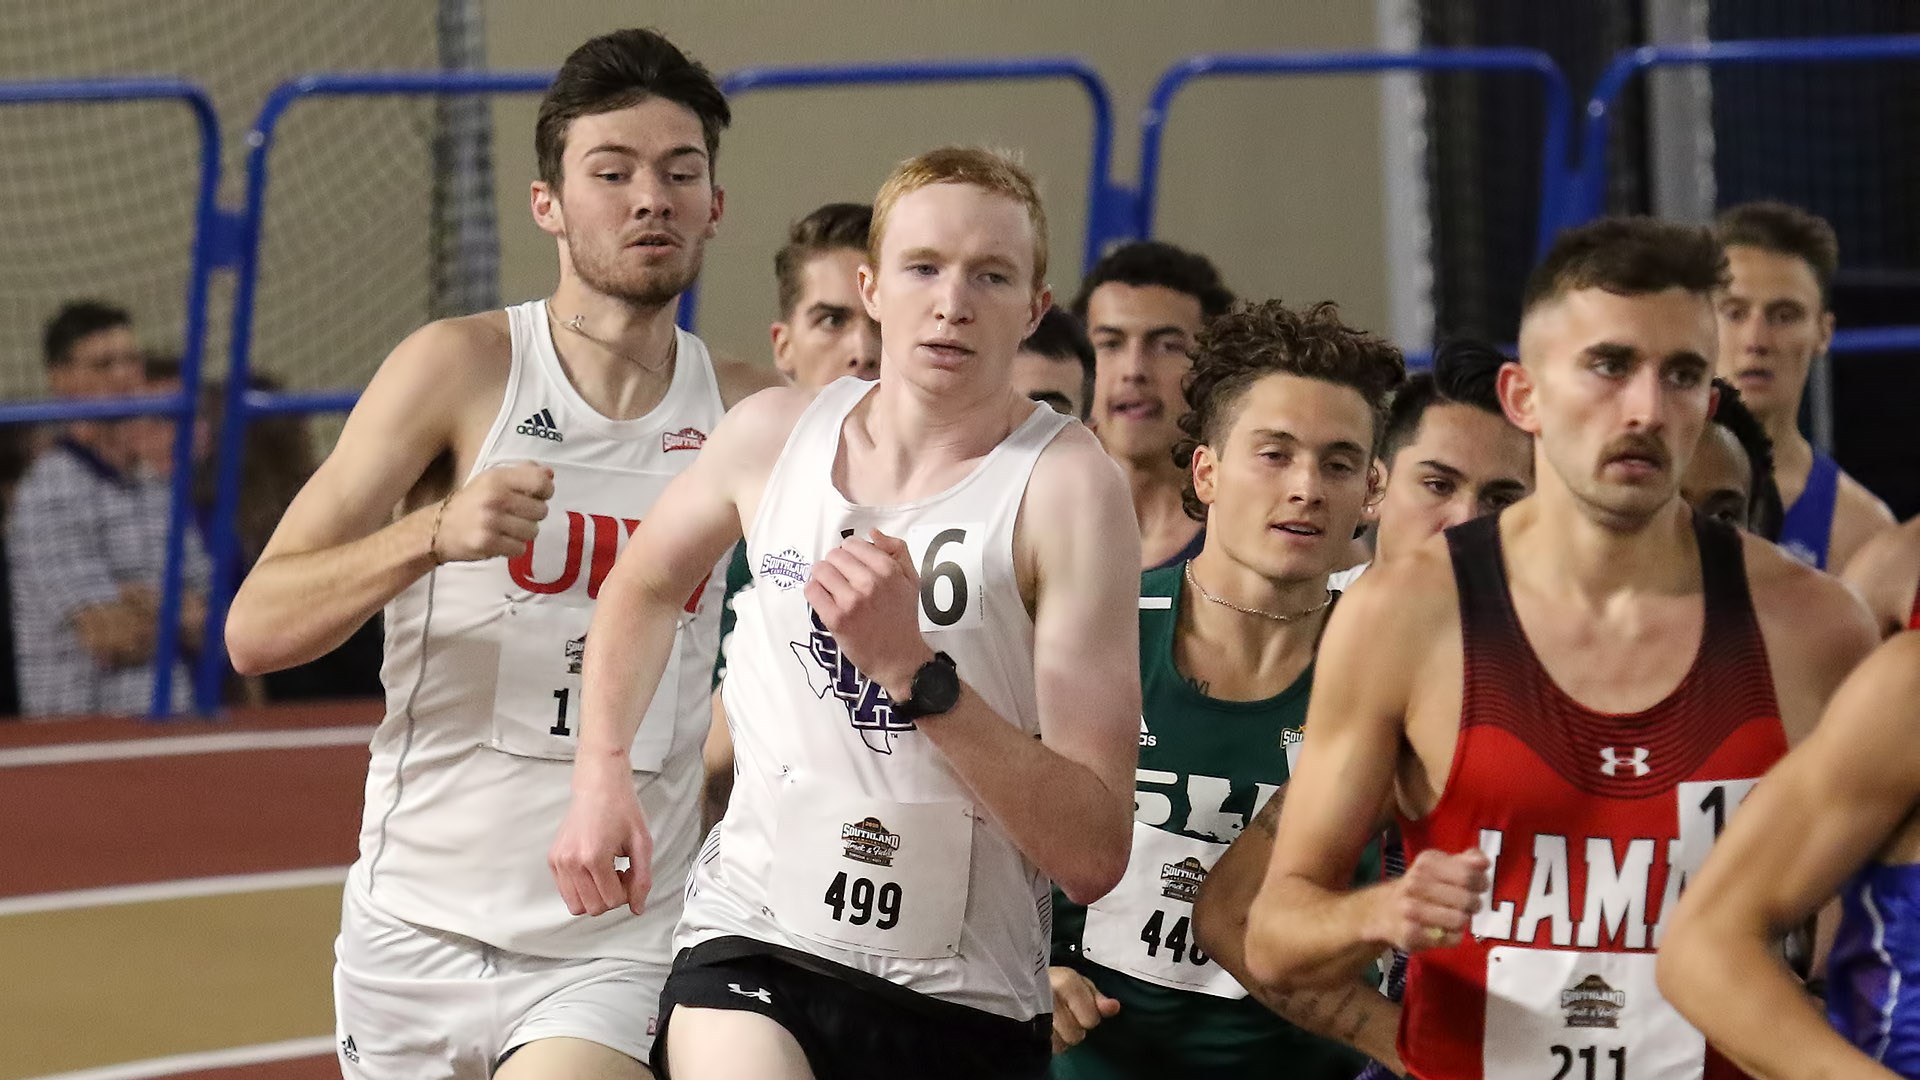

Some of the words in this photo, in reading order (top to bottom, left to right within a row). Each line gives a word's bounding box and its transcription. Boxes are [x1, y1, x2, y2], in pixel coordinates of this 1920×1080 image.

[517, 423, 563, 442] adidas
[920, 529, 968, 626] 6
[842, 823, 900, 850] SOUTHLAND
[1161, 864, 1207, 883] SOUTHLA
[824, 871, 902, 930] 499
[1551, 1045, 1627, 1080] 211
